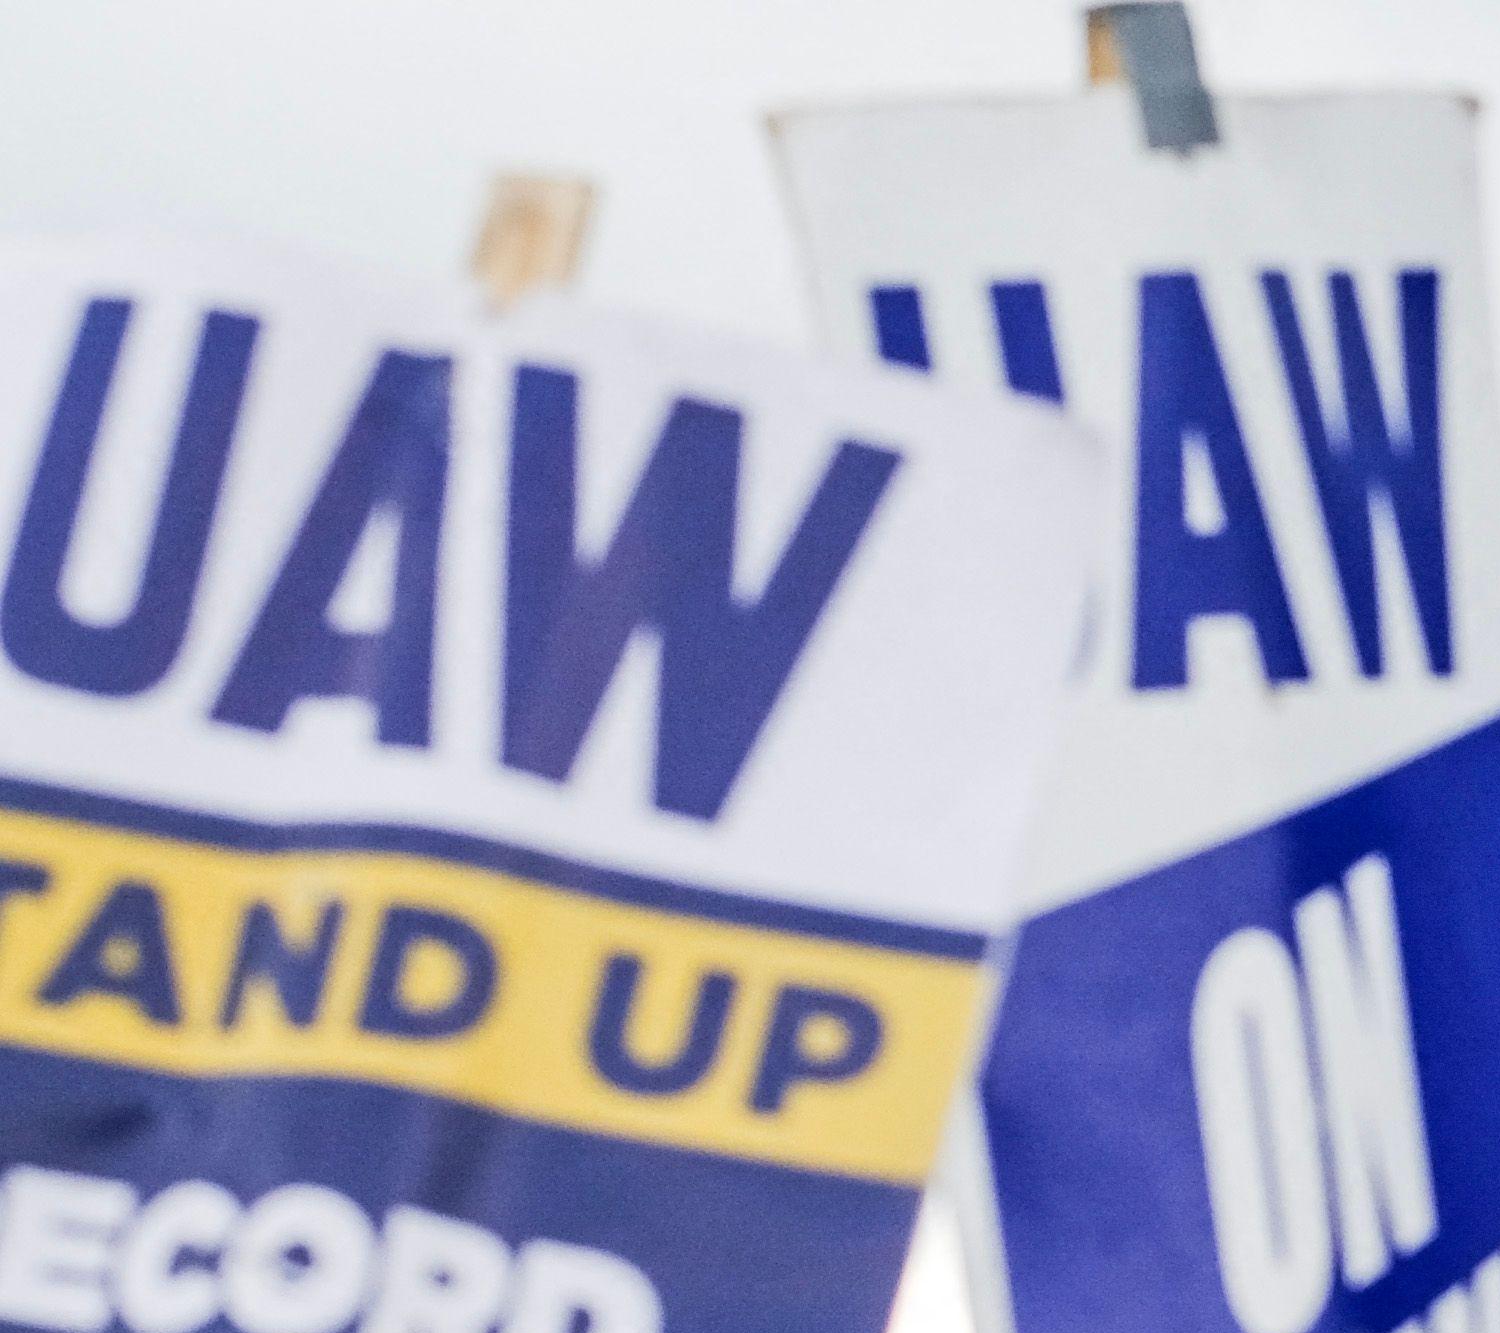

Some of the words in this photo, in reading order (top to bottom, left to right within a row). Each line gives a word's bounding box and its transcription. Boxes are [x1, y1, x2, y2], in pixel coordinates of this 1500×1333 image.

[0, 296, 905, 826] UAW
[868, 269, 1455, 692] AW
[583, 950, 887, 1117] UP
